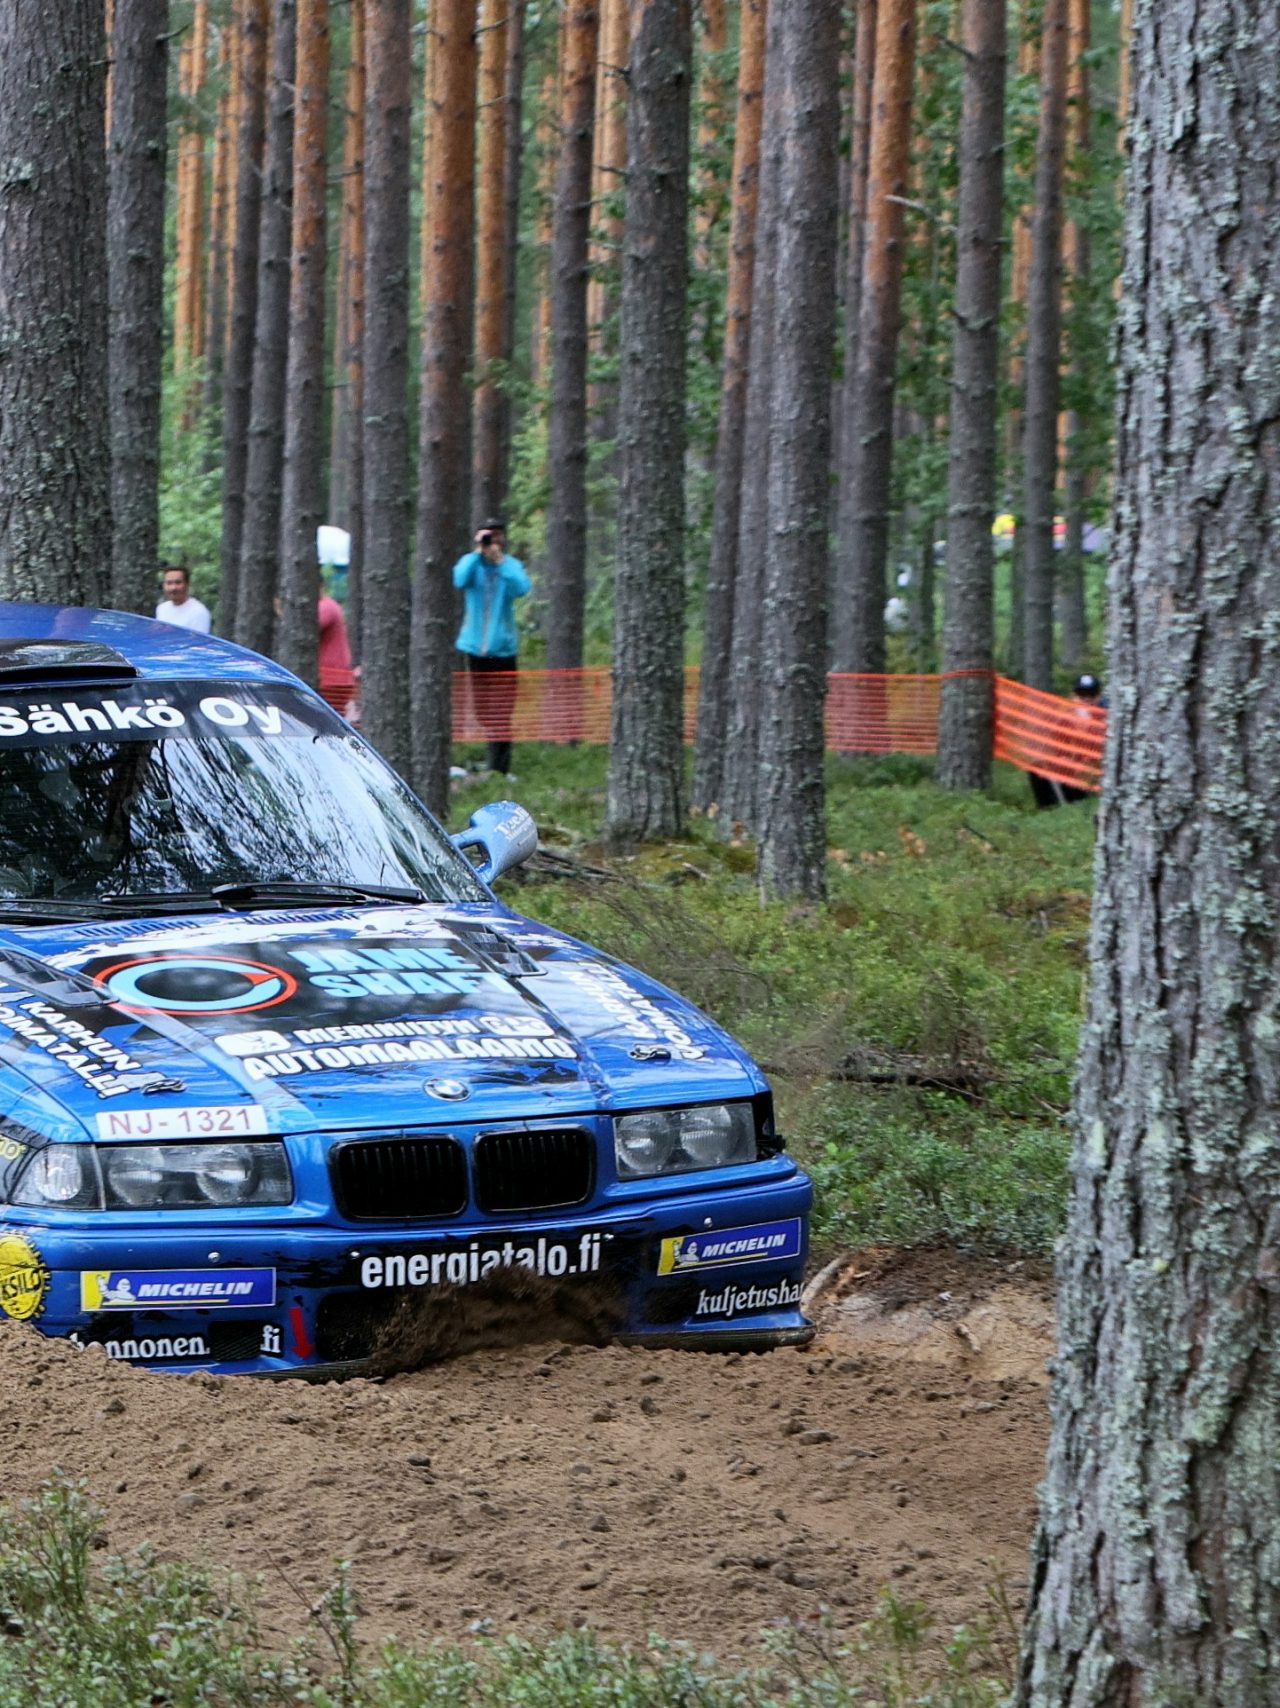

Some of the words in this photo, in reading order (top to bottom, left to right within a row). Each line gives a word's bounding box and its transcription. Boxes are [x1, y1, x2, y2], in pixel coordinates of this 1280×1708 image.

[198, 696, 284, 735] Oy
[286, 947, 481, 973] JAME
[308, 971, 522, 998] SHAFT
[19, 1001, 143, 1072] KARHUN
[241, 1037, 579, 1081] AUTOMAALAAMO
[108, 1108, 252, 1136] NJ-1321
[701, 1233, 787, 1258] MICHELIN
[360, 1232, 602, 1288] energiatalo.fi
[137, 1281, 254, 1299] MICHELIN
